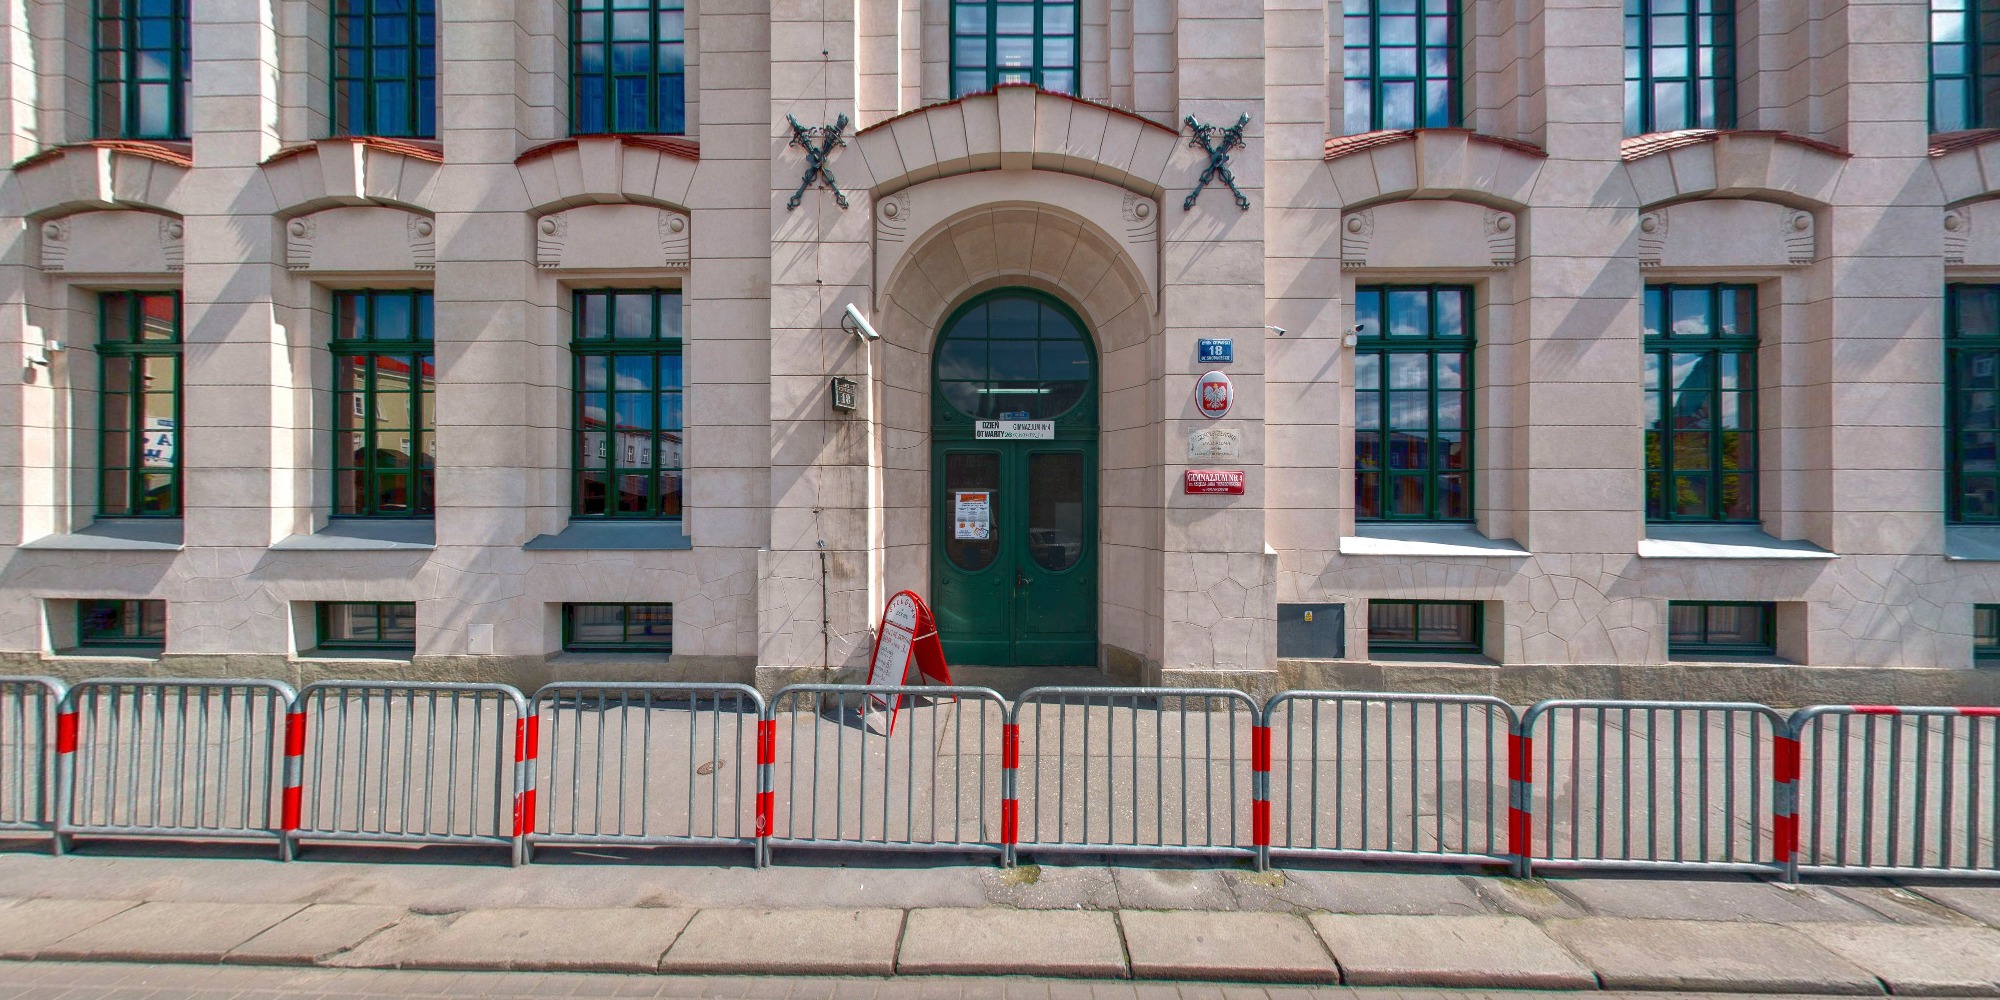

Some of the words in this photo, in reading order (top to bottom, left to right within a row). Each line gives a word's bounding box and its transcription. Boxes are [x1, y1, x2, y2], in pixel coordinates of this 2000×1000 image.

[1209, 346, 1223, 356] 18
[841, 393, 851, 404] 18
[982, 421, 999, 429] DZIEŃ
[1013, 423, 1041, 431] GIMNAZJUM
[1188, 473, 1228, 482] GIMNAZJUM
[1228, 473, 1239, 482] NR
